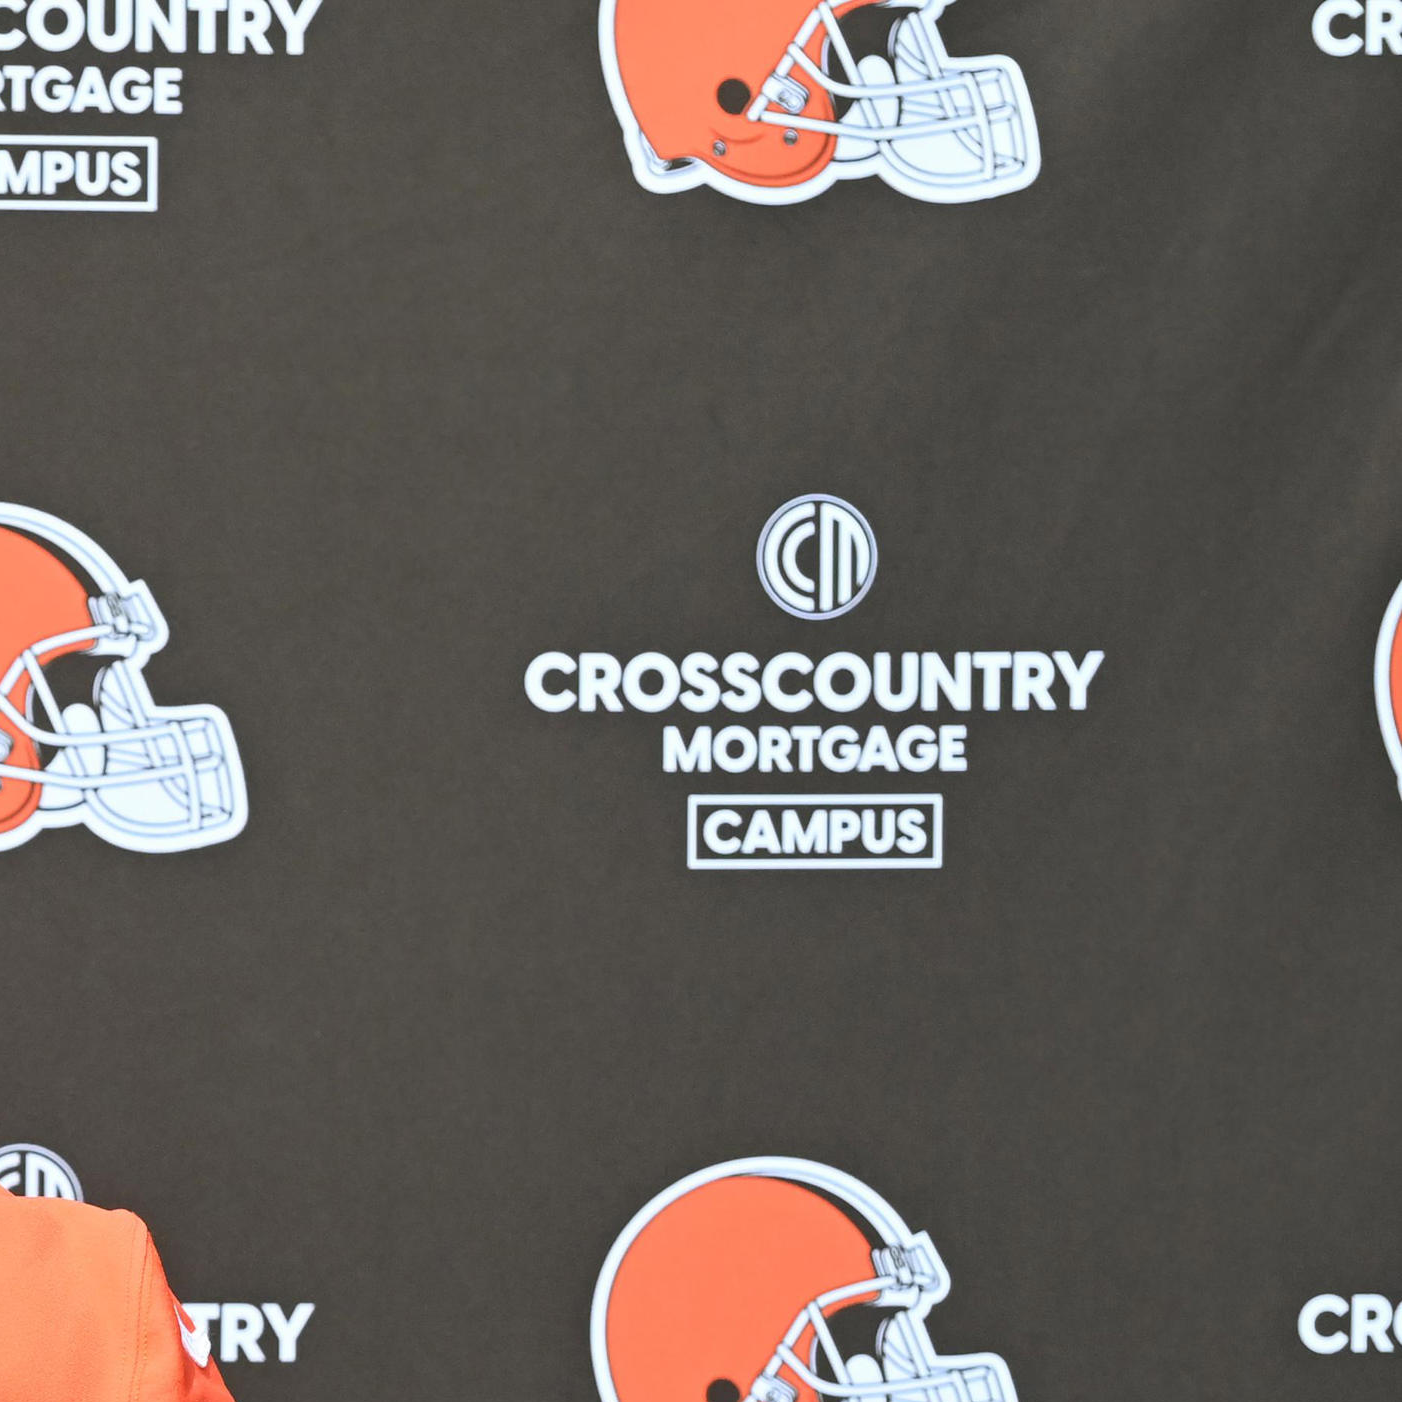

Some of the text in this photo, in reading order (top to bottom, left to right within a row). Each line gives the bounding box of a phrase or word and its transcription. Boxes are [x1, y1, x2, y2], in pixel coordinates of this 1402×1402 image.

[523, 650, 1106, 713] CROSSCOUNTRY
[662, 724, 968, 774] MORTGAGE
[702, 808, 928, 855] CAMPUS
